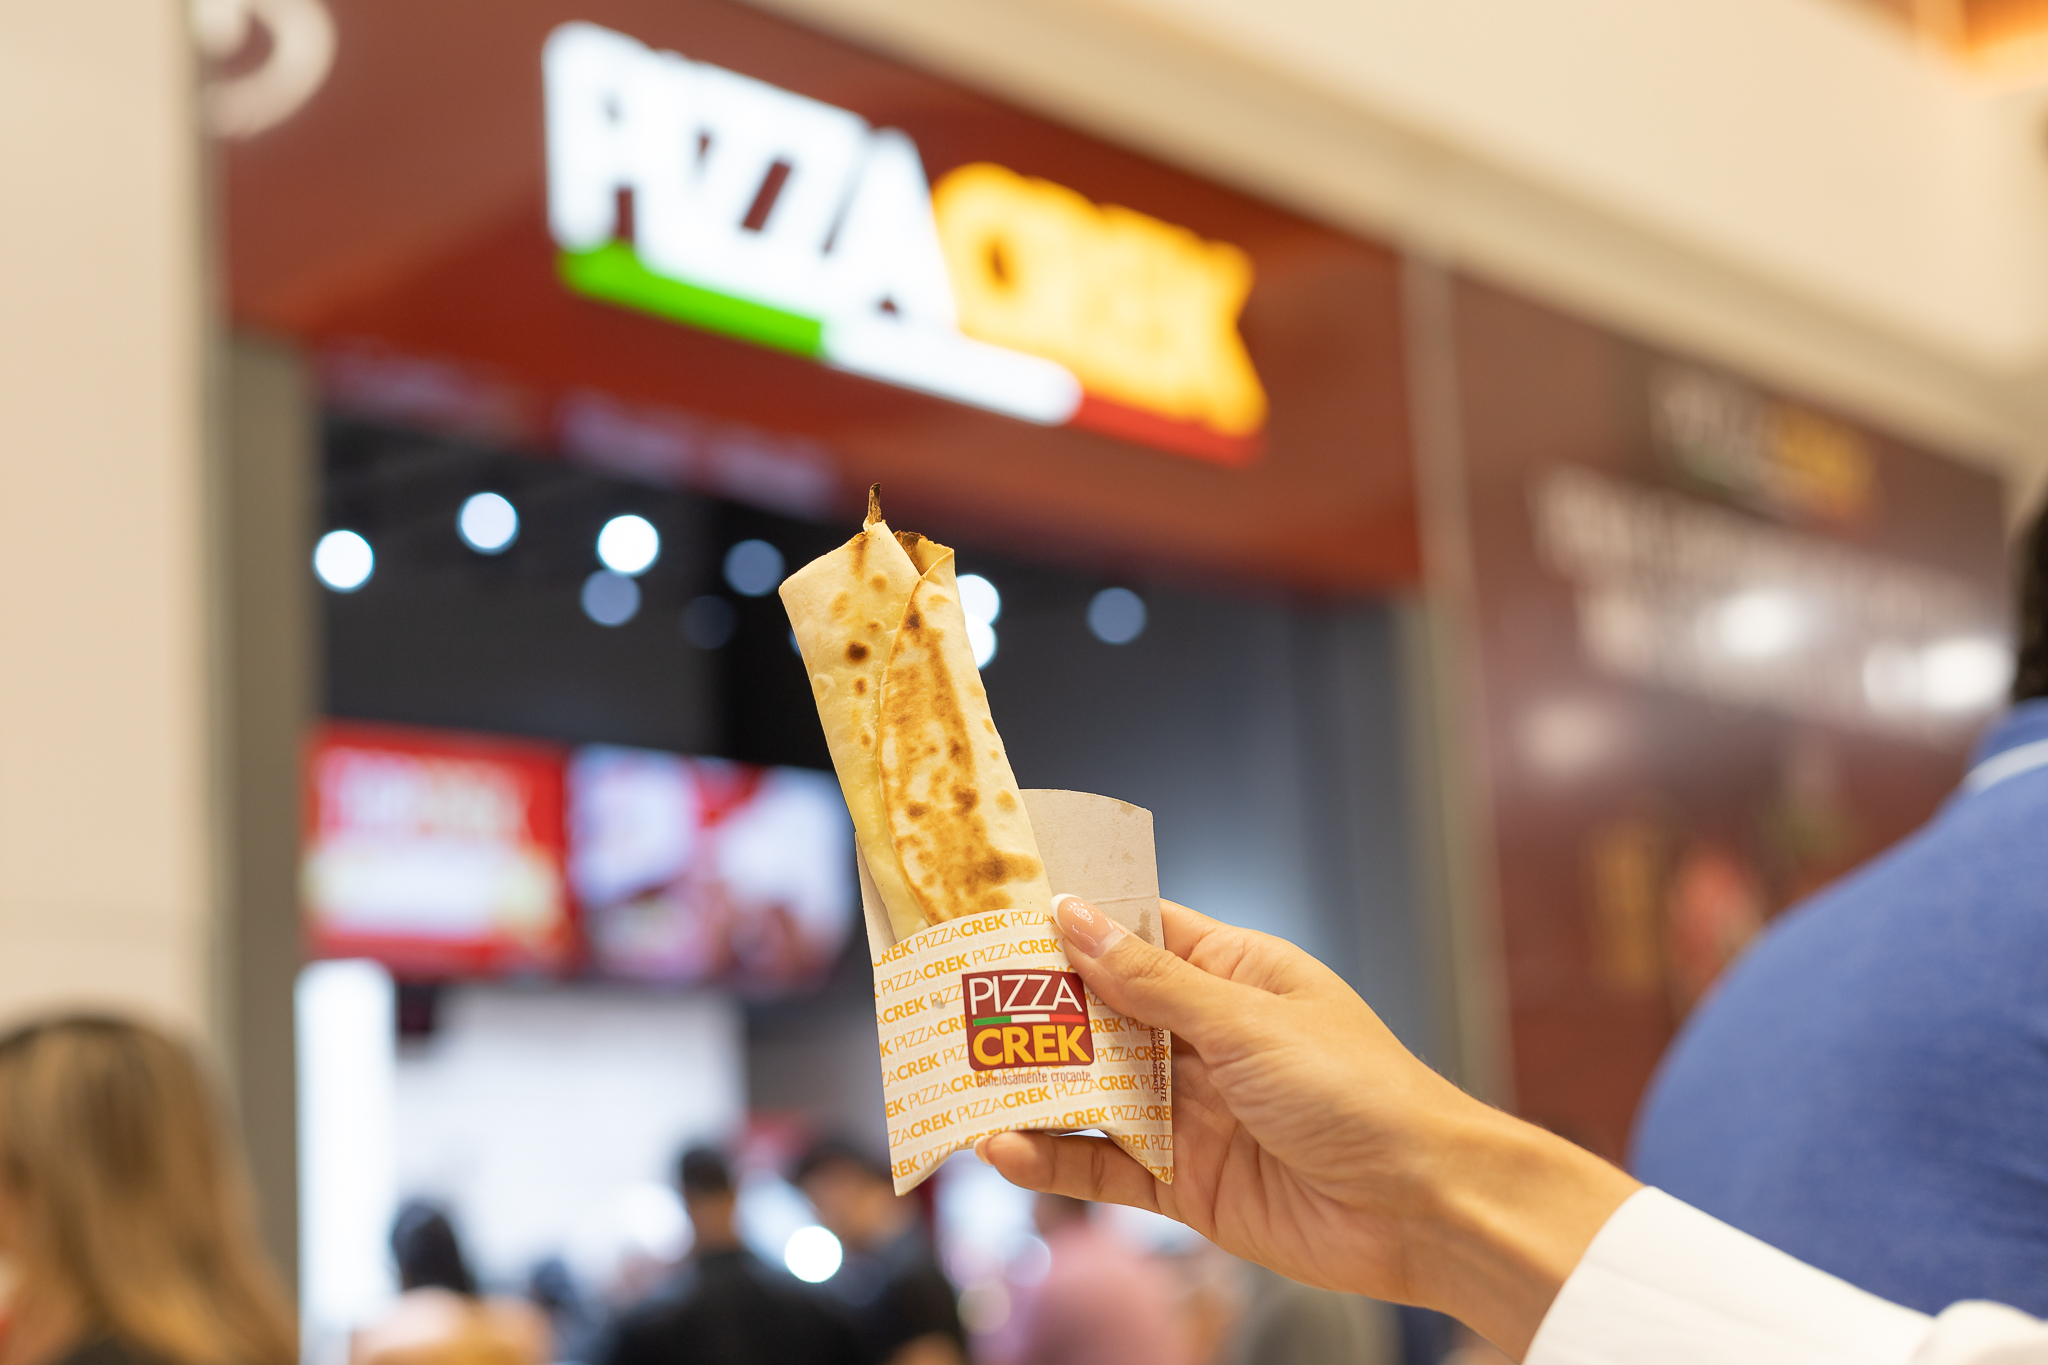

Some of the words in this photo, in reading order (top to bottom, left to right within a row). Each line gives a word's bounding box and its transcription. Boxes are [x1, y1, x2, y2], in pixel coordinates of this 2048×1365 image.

[915, 913, 1009, 951] PIZZACREK
[881, 953, 971, 995] PIZZACREK
[972, 938, 1062, 965] PIZZACREK
[969, 974, 1083, 1015] PIZZA
[973, 1026, 1092, 1065] CREK
[1051, 1070, 1091, 1083] crocante
[1159, 1061, 1167, 1102] QUENTE
[956, 1085, 1052, 1122] PIZZACREK
